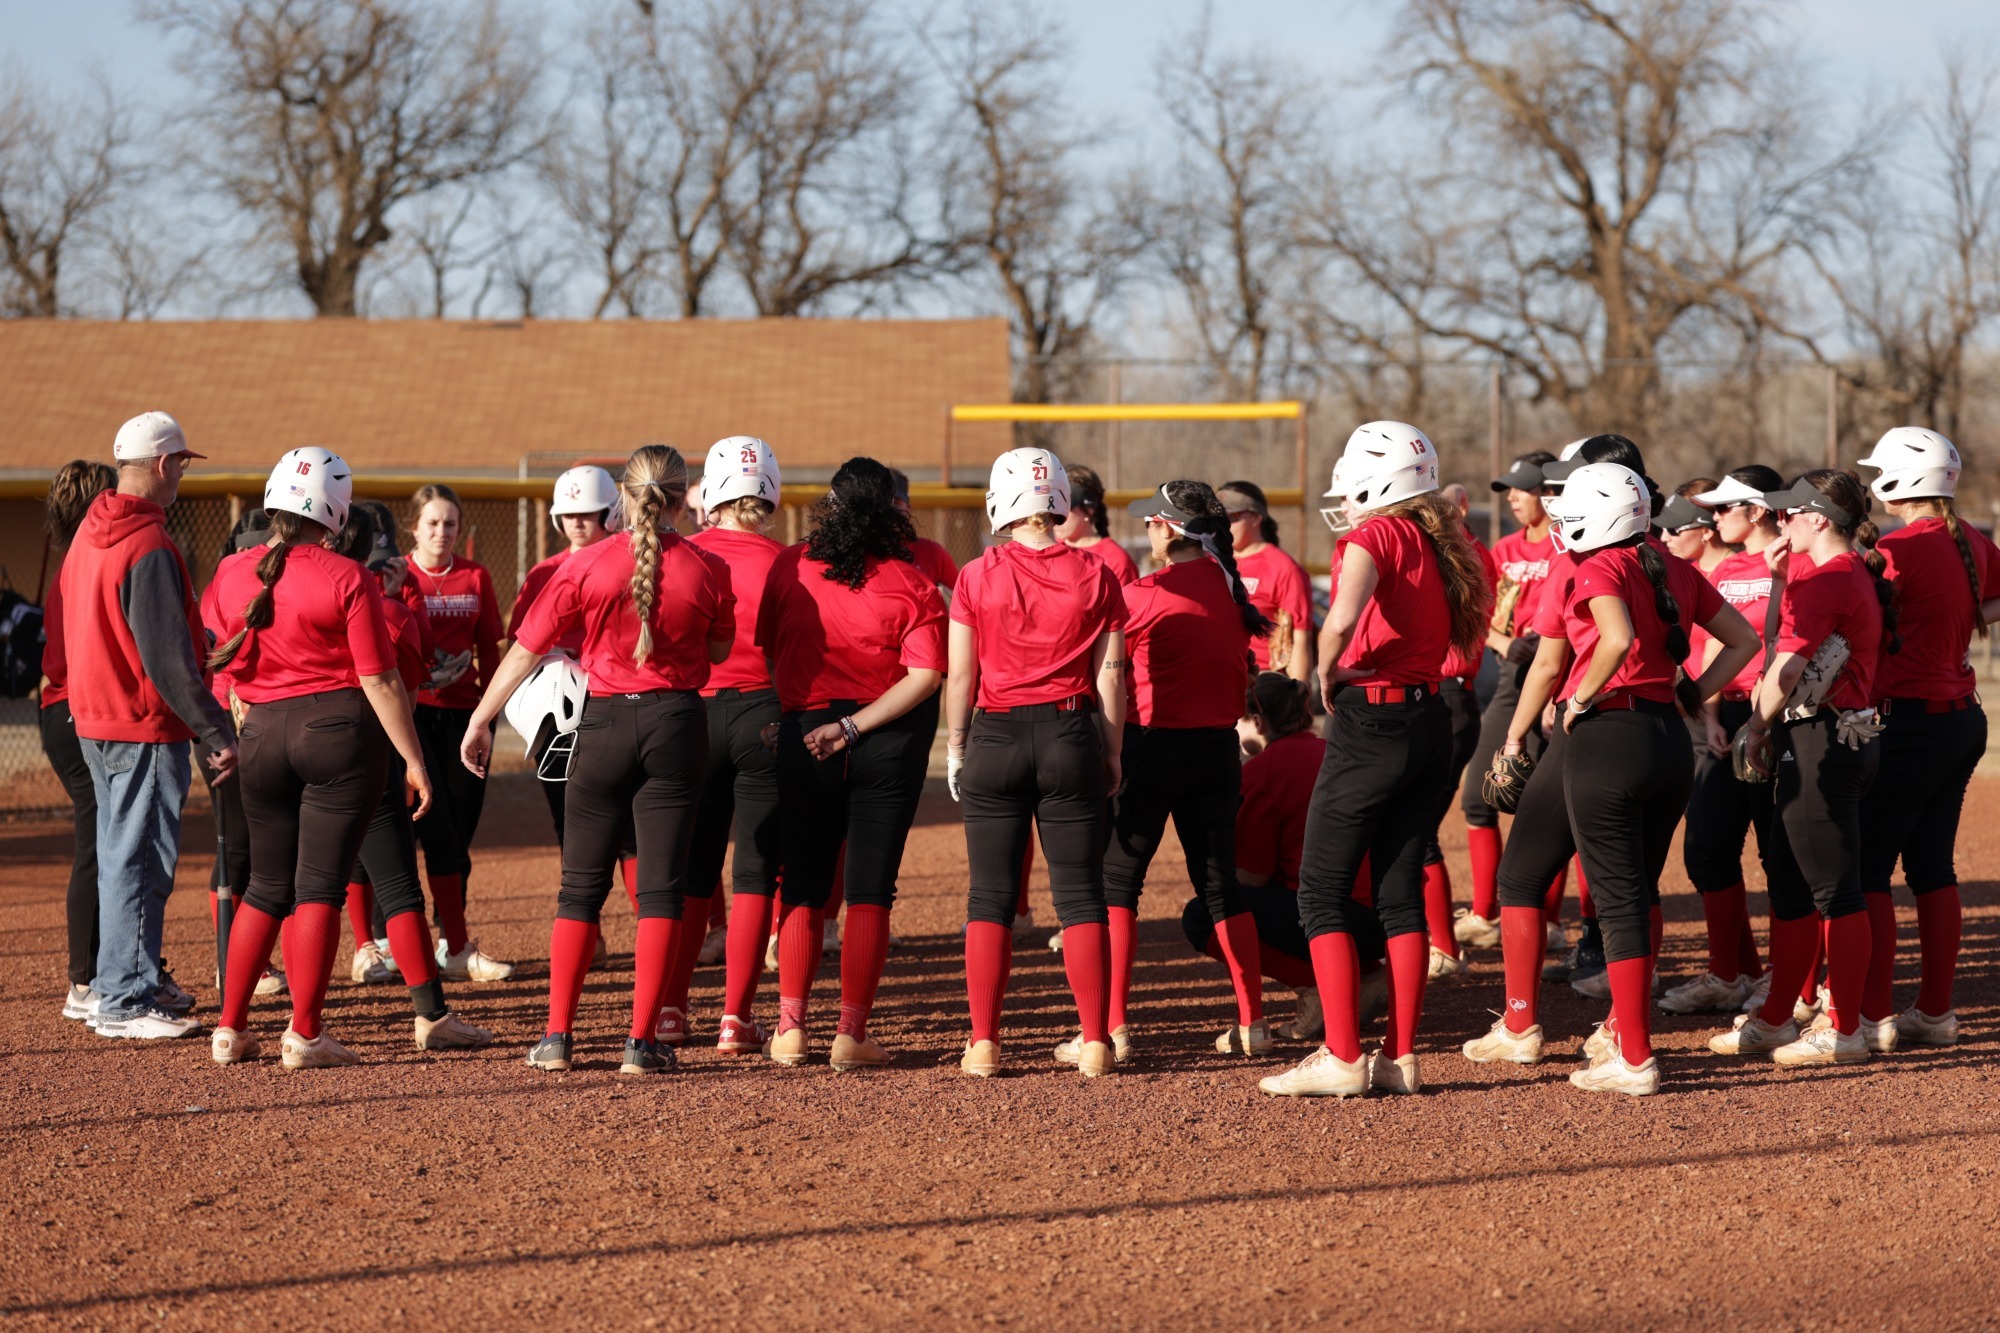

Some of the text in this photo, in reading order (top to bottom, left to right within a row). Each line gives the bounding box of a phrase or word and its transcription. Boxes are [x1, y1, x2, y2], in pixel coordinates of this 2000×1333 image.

[1410, 439, 1426, 455] 13
[741, 450, 757, 463] 25
[296, 461, 312, 476] 16
[1032, 466, 1048, 480] 27
[1632, 486, 1641, 501] 7
